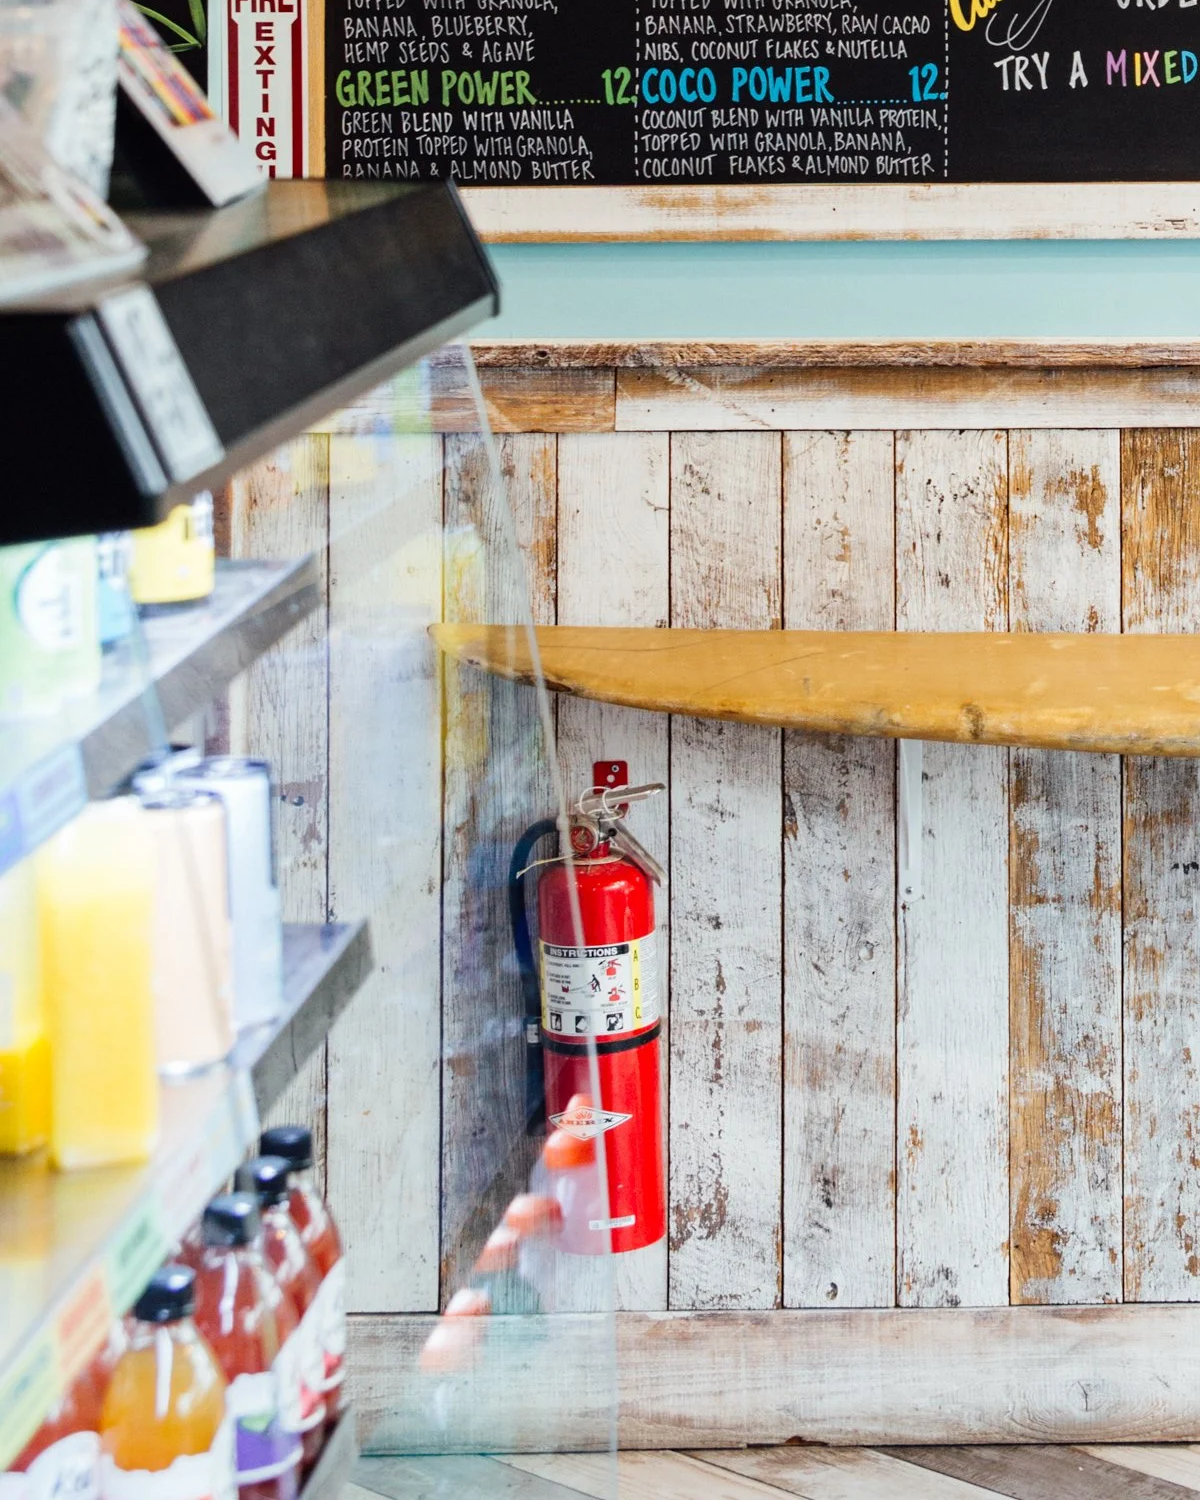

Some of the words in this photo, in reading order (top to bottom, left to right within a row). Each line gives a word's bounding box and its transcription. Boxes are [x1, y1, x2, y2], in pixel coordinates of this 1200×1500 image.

[993, 51, 1050, 92] TRY
[1068, 50, 1089, 89] A
[1106, 48, 1198, 88] MIXED
